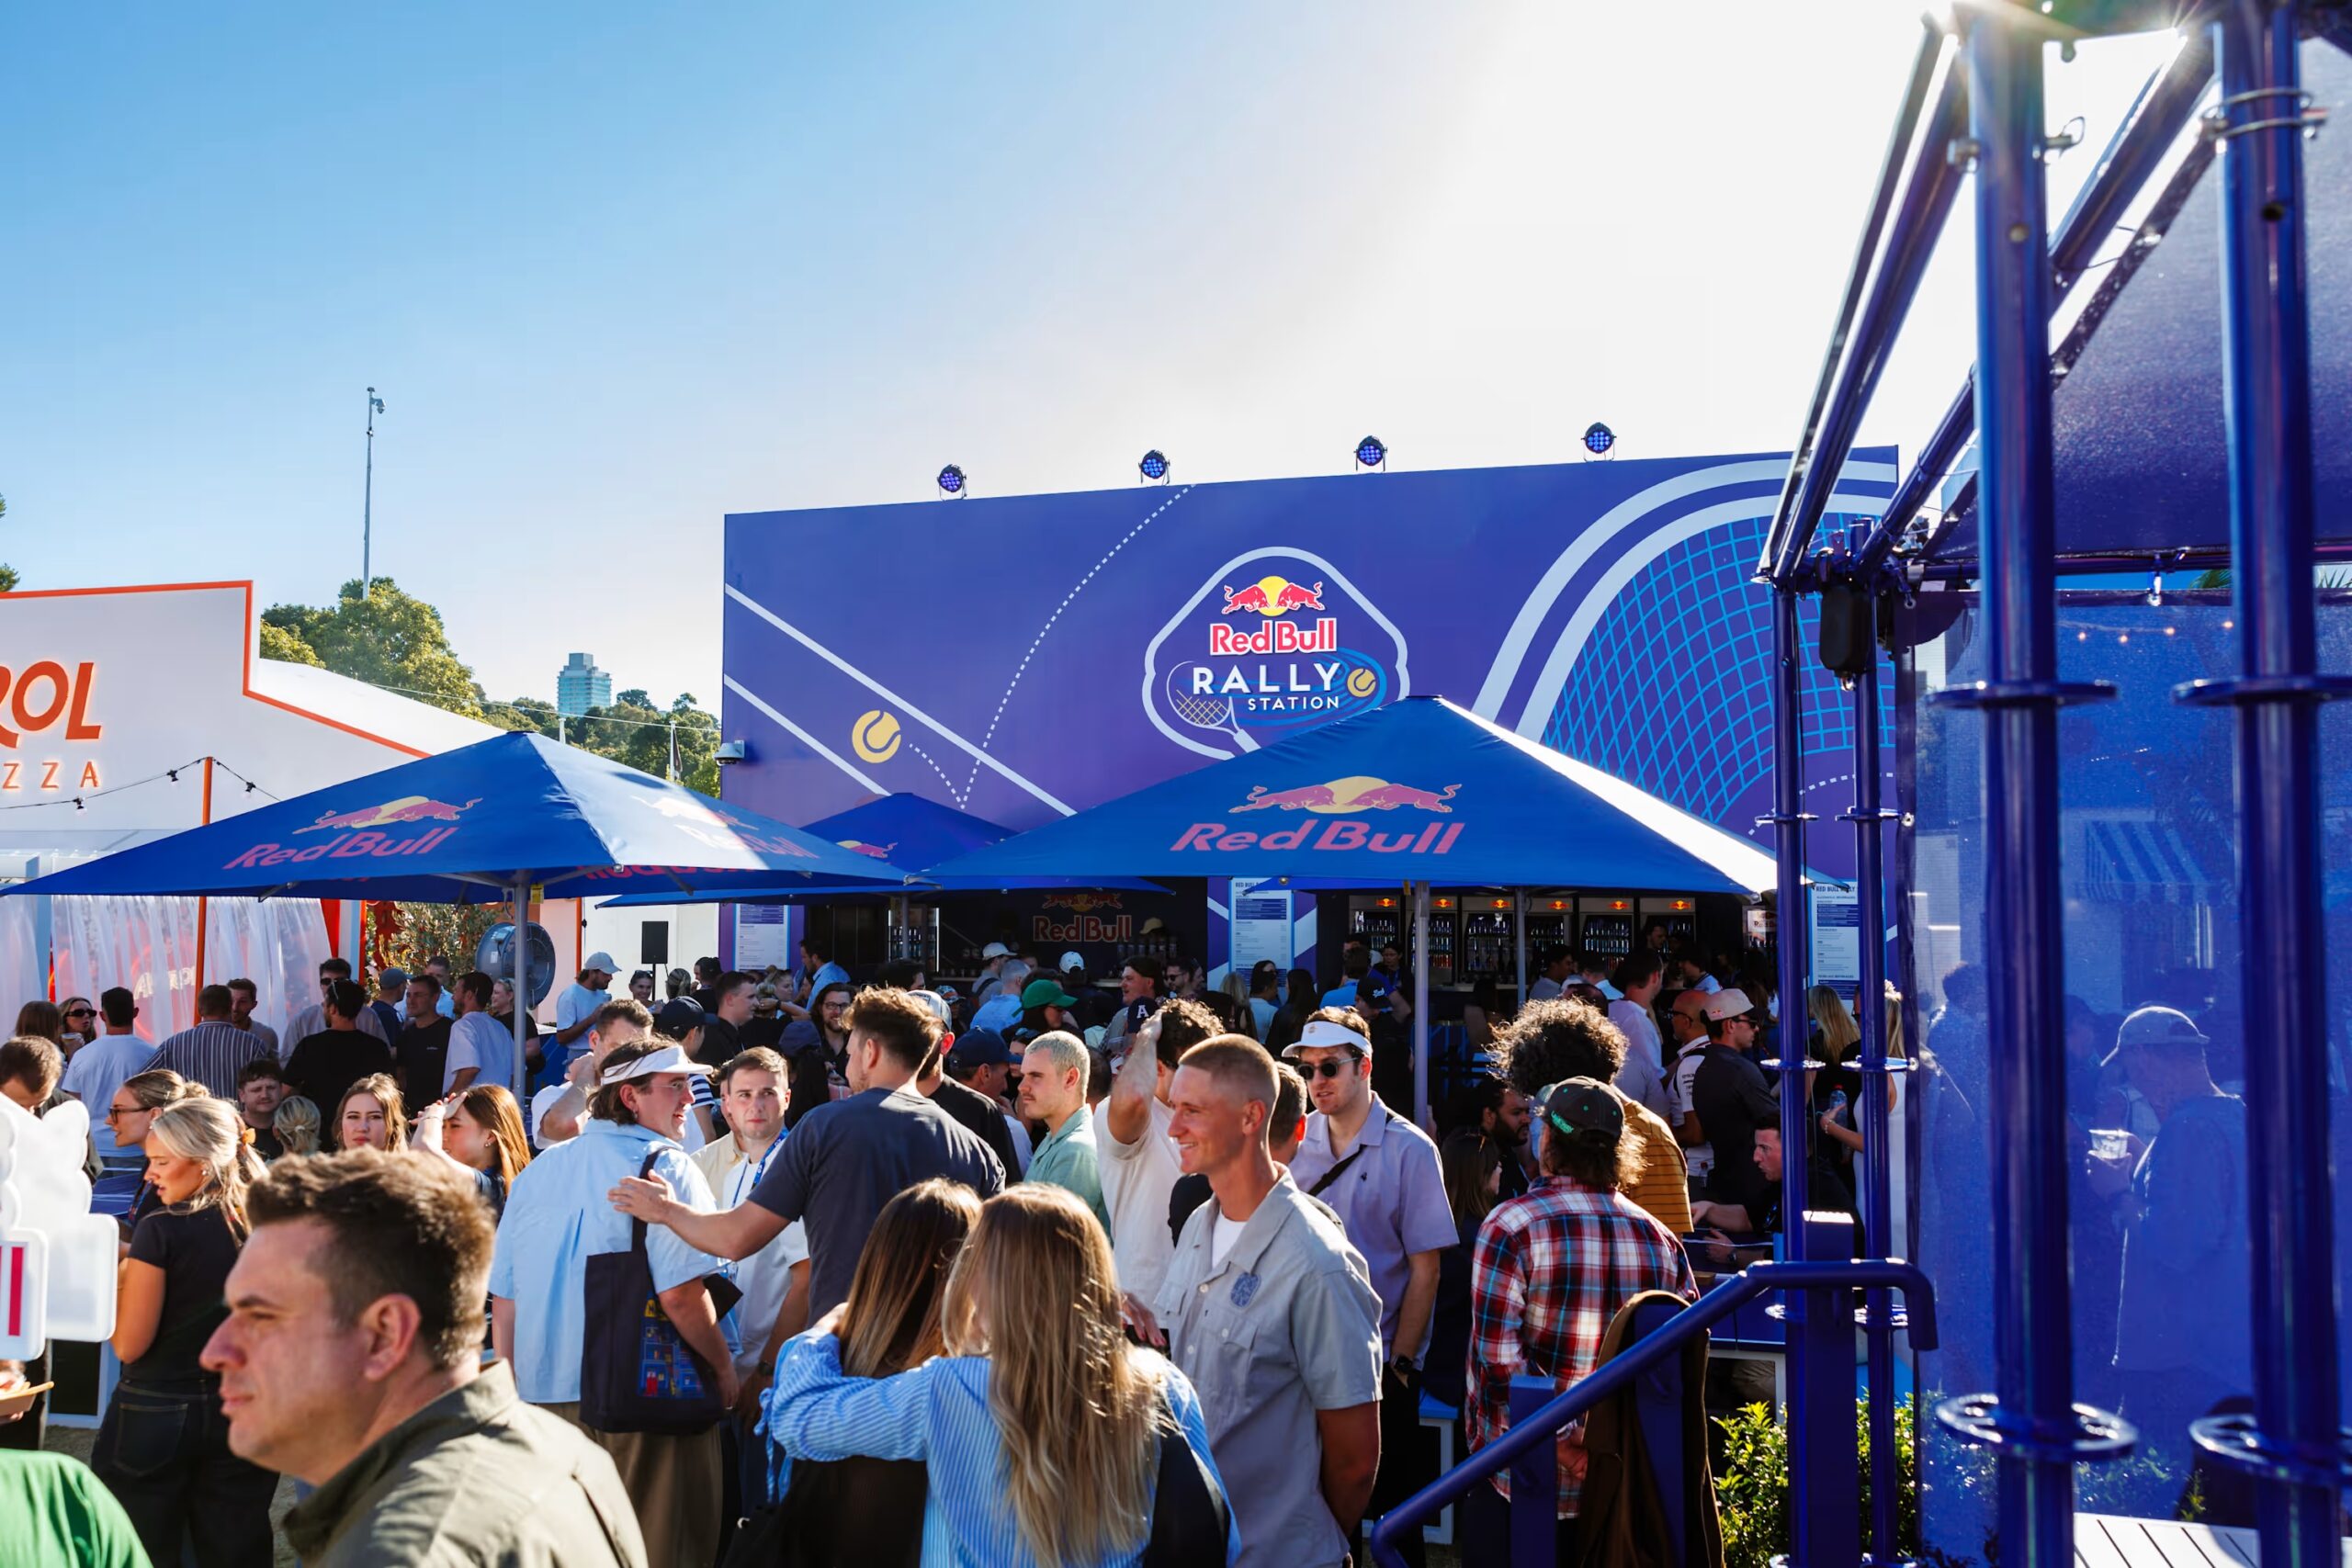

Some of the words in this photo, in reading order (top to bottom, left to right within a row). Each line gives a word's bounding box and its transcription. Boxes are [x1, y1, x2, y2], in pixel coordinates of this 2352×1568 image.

[1210, 618, 1272, 655] Red
[1274, 617, 1337, 653] Bull
[1193, 662, 1340, 694] RALLY
[1248, 696, 1339, 710] STATION
[221, 833, 353, 870] Red
[328, 827, 459, 858] Bull
[1170, 819, 1318, 852] Red
[1313, 820, 1465, 854] Bull
[1033, 915, 1082, 942] Red
[1084, 915, 1132, 942] Bull
[1136, 1004, 1149, 1019] A
